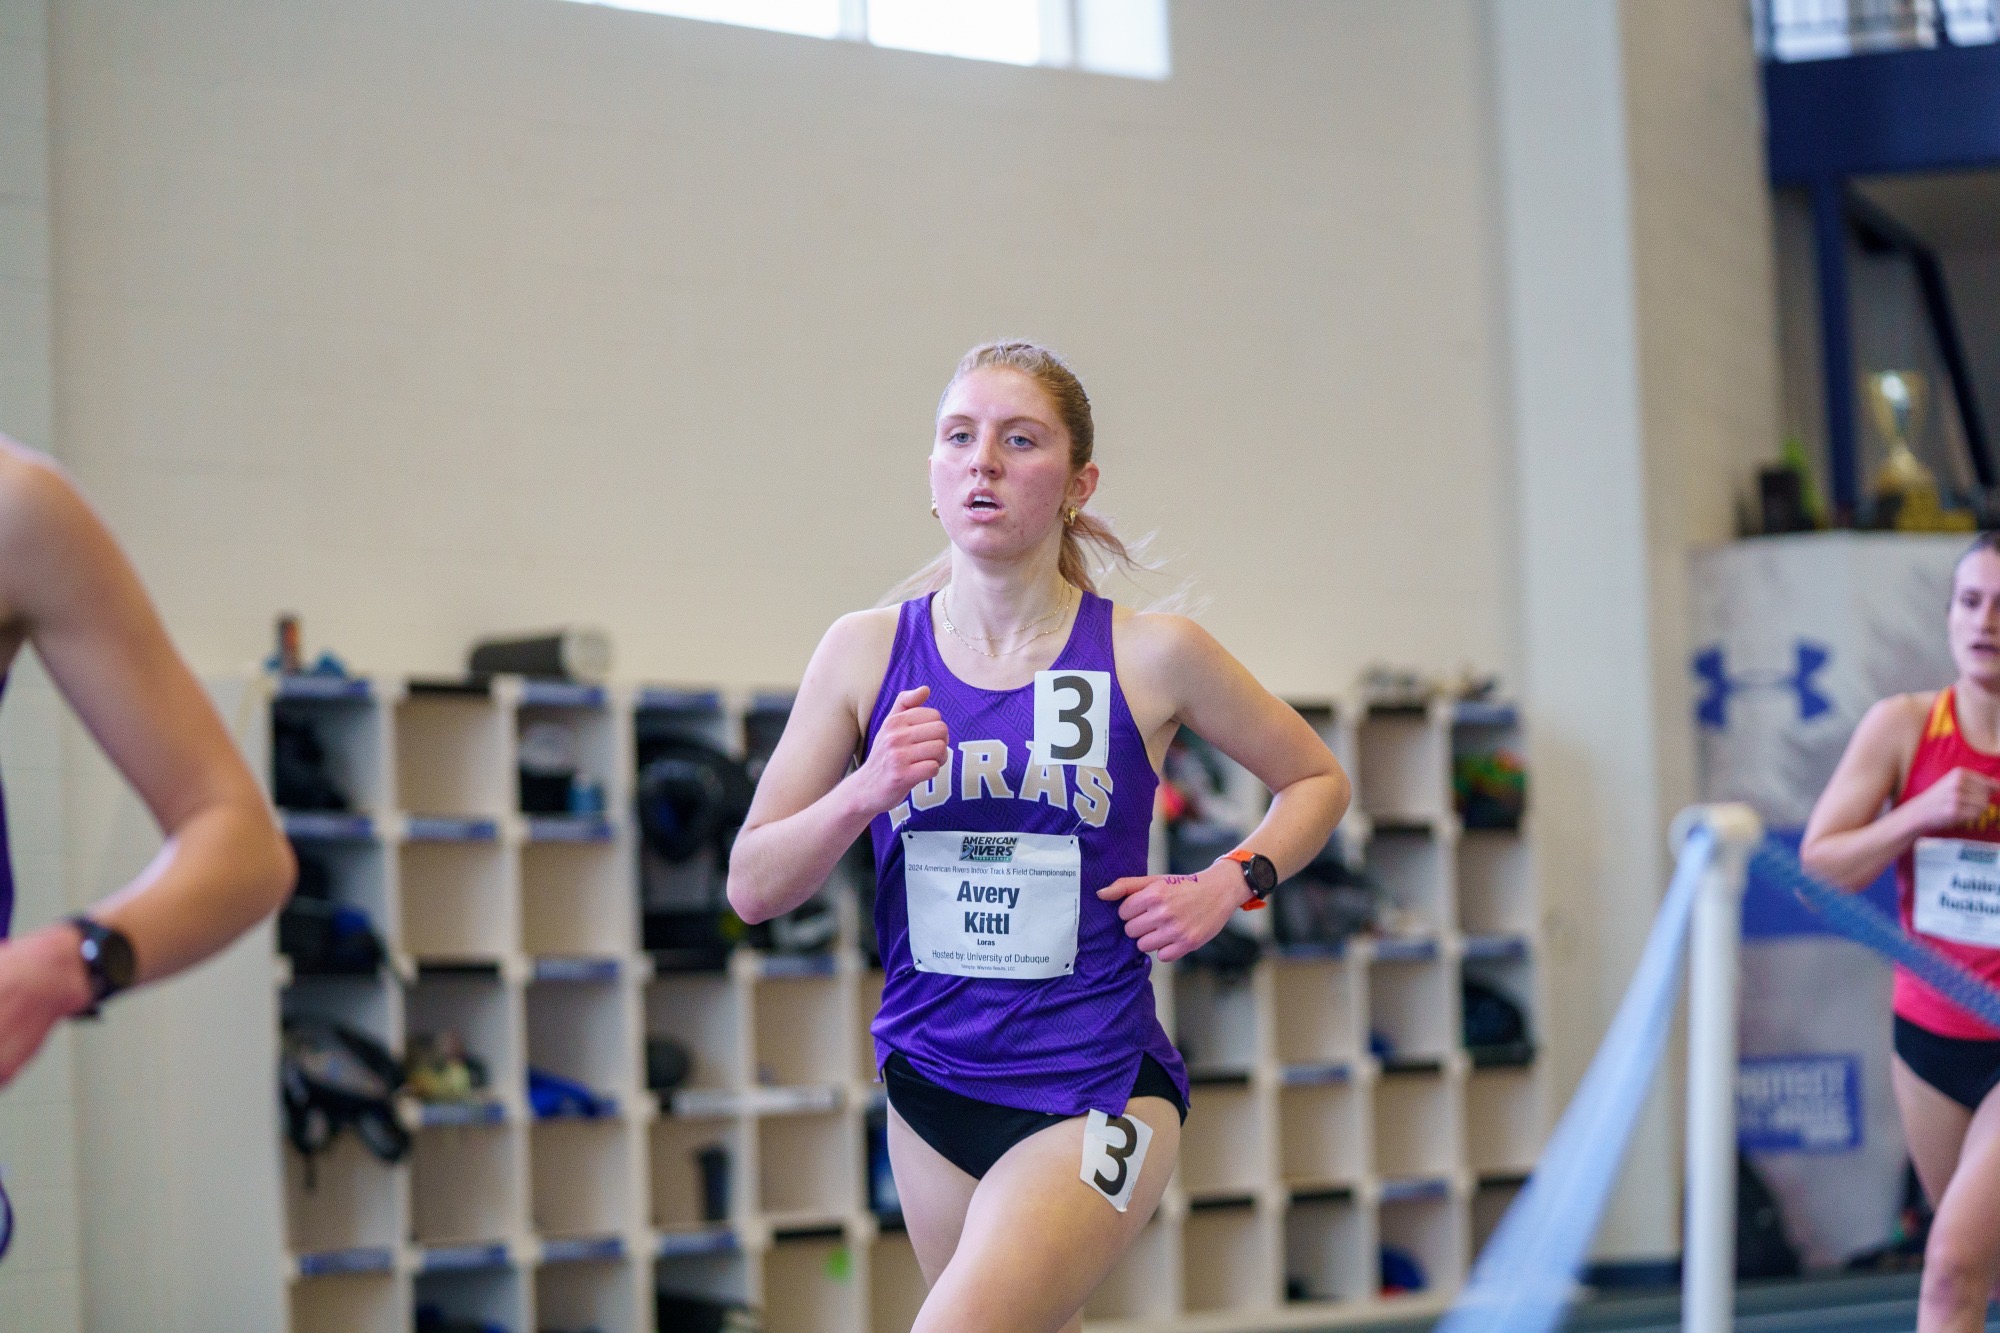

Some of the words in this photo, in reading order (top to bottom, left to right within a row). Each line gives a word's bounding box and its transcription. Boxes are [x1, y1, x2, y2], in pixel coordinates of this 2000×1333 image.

[1050, 675, 1094, 760] 3
[888, 738, 1114, 832] ORAS
[962, 836, 1018, 845] AMERICAN
[961, 844, 1015, 860] RIVERS
[908, 864, 923, 872] 2024
[924, 864, 952, 873] American
[990, 867, 1004, 875] Track
[1012, 868, 1028, 876] Field
[1028, 869, 1077, 878] Championships
[956, 880, 1020, 909] Avery
[964, 911, 1010, 935] Kittl
[977, 938, 996, 946] Loras
[932, 950, 954, 959] Hosted
[955, 951, 965, 962] by:
[966, 952, 1003, 964] University
[1004, 954, 1012, 963] of
[1014, 954, 1050, 965] Dubuque
[1093, 1114, 1137, 1196] 3
